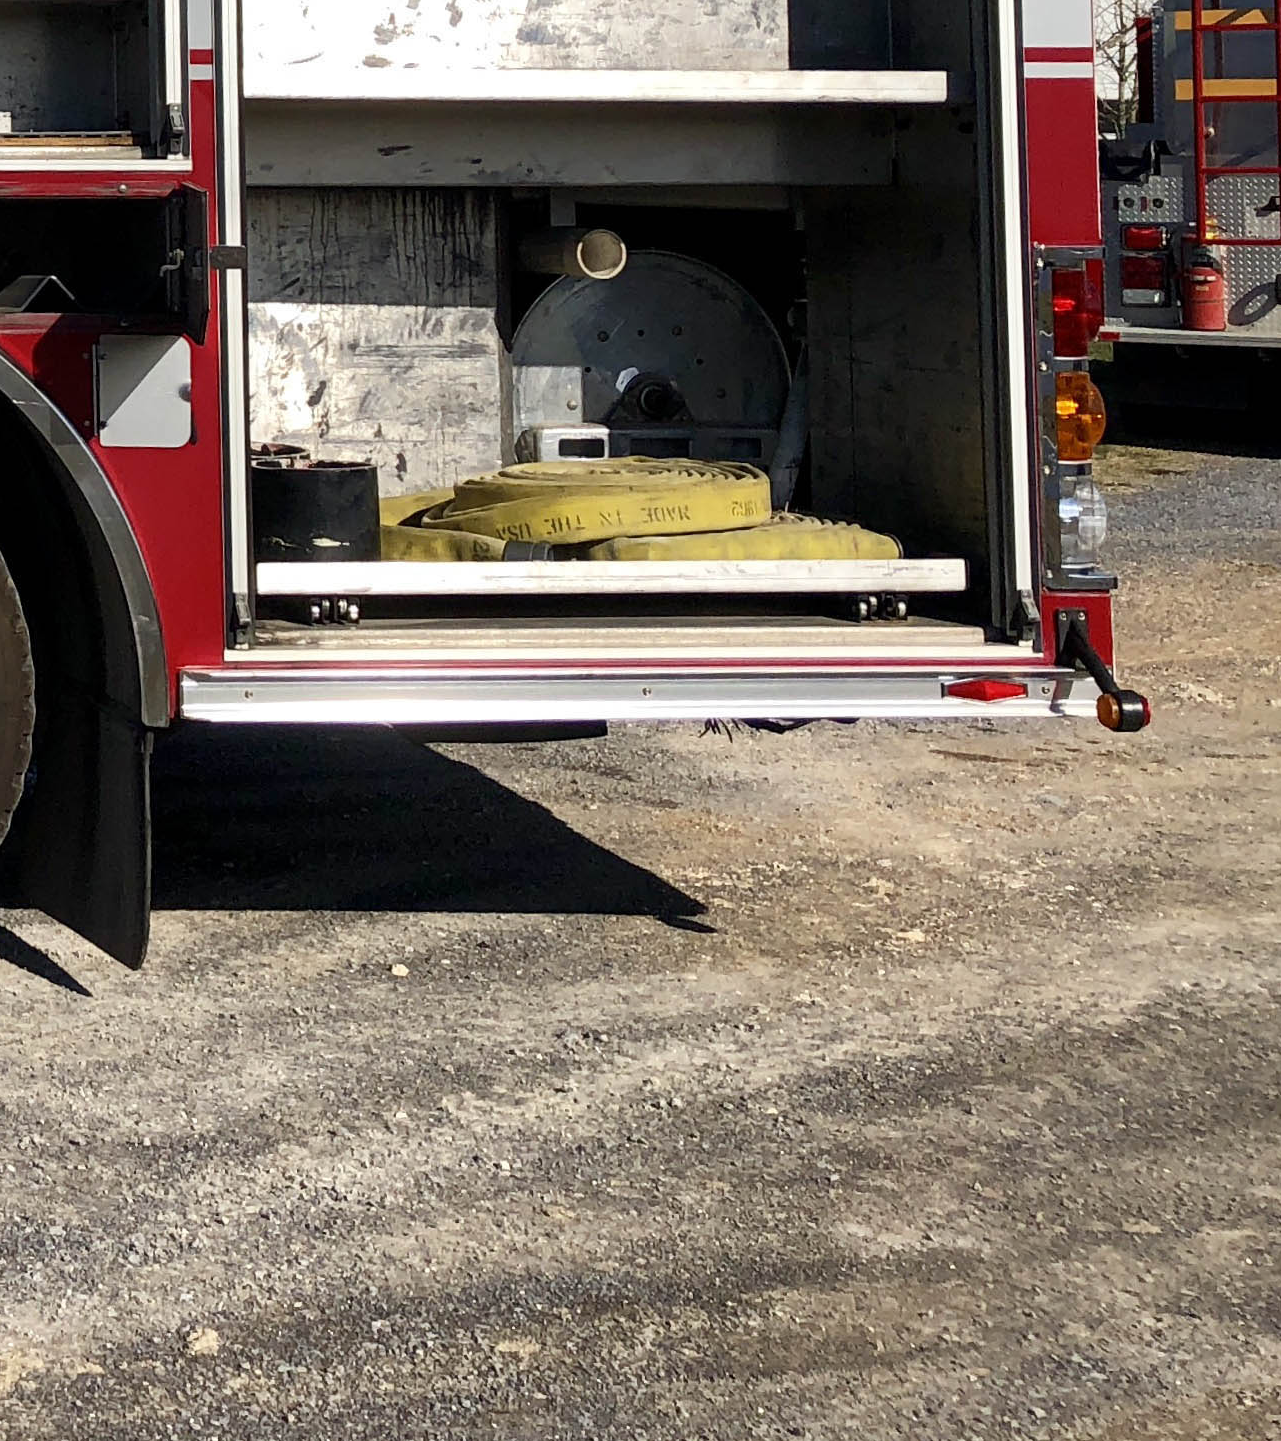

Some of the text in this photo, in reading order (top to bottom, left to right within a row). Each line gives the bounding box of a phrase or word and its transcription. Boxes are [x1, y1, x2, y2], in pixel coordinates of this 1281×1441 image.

[495, 504, 691, 541] MADE IN THE USA
